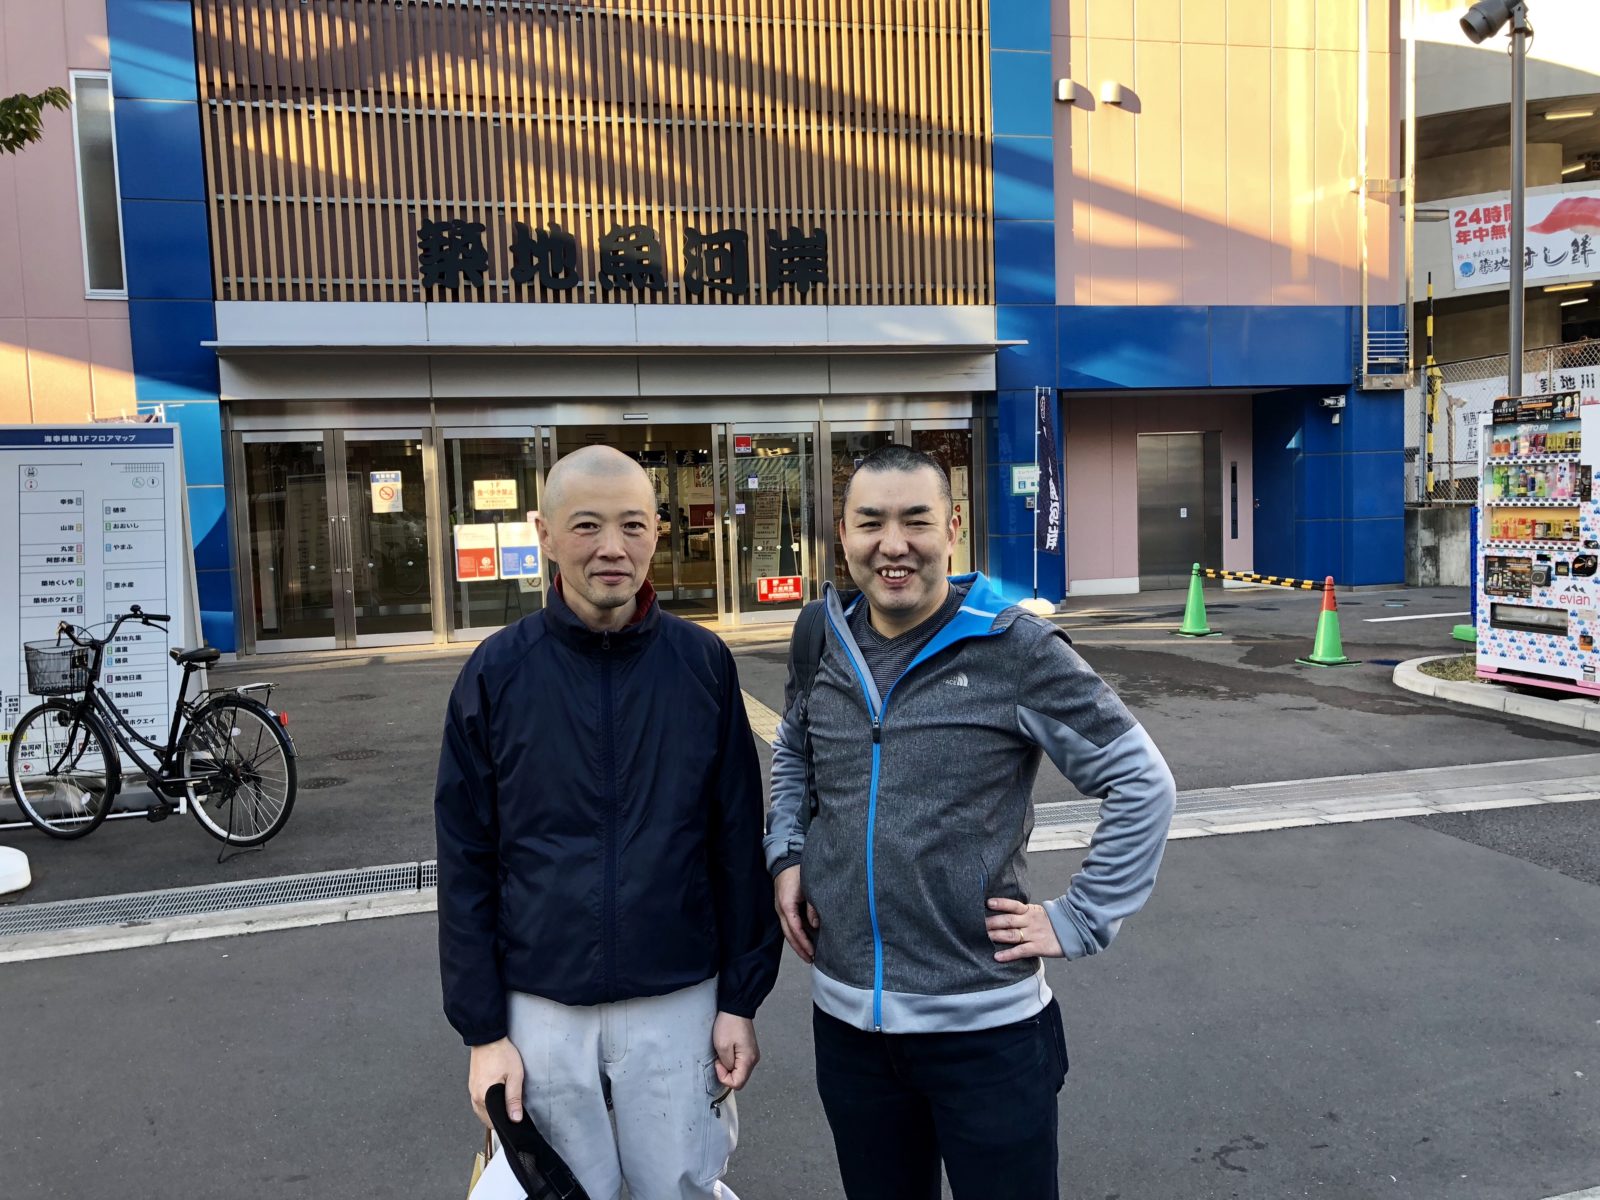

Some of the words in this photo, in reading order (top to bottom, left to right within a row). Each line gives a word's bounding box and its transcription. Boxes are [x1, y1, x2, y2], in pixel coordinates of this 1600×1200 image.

[1456, 225, 1511, 245] 年中無
[417, 218, 830, 296] 築地魚河岸
[1559, 594, 1590, 606] evian
